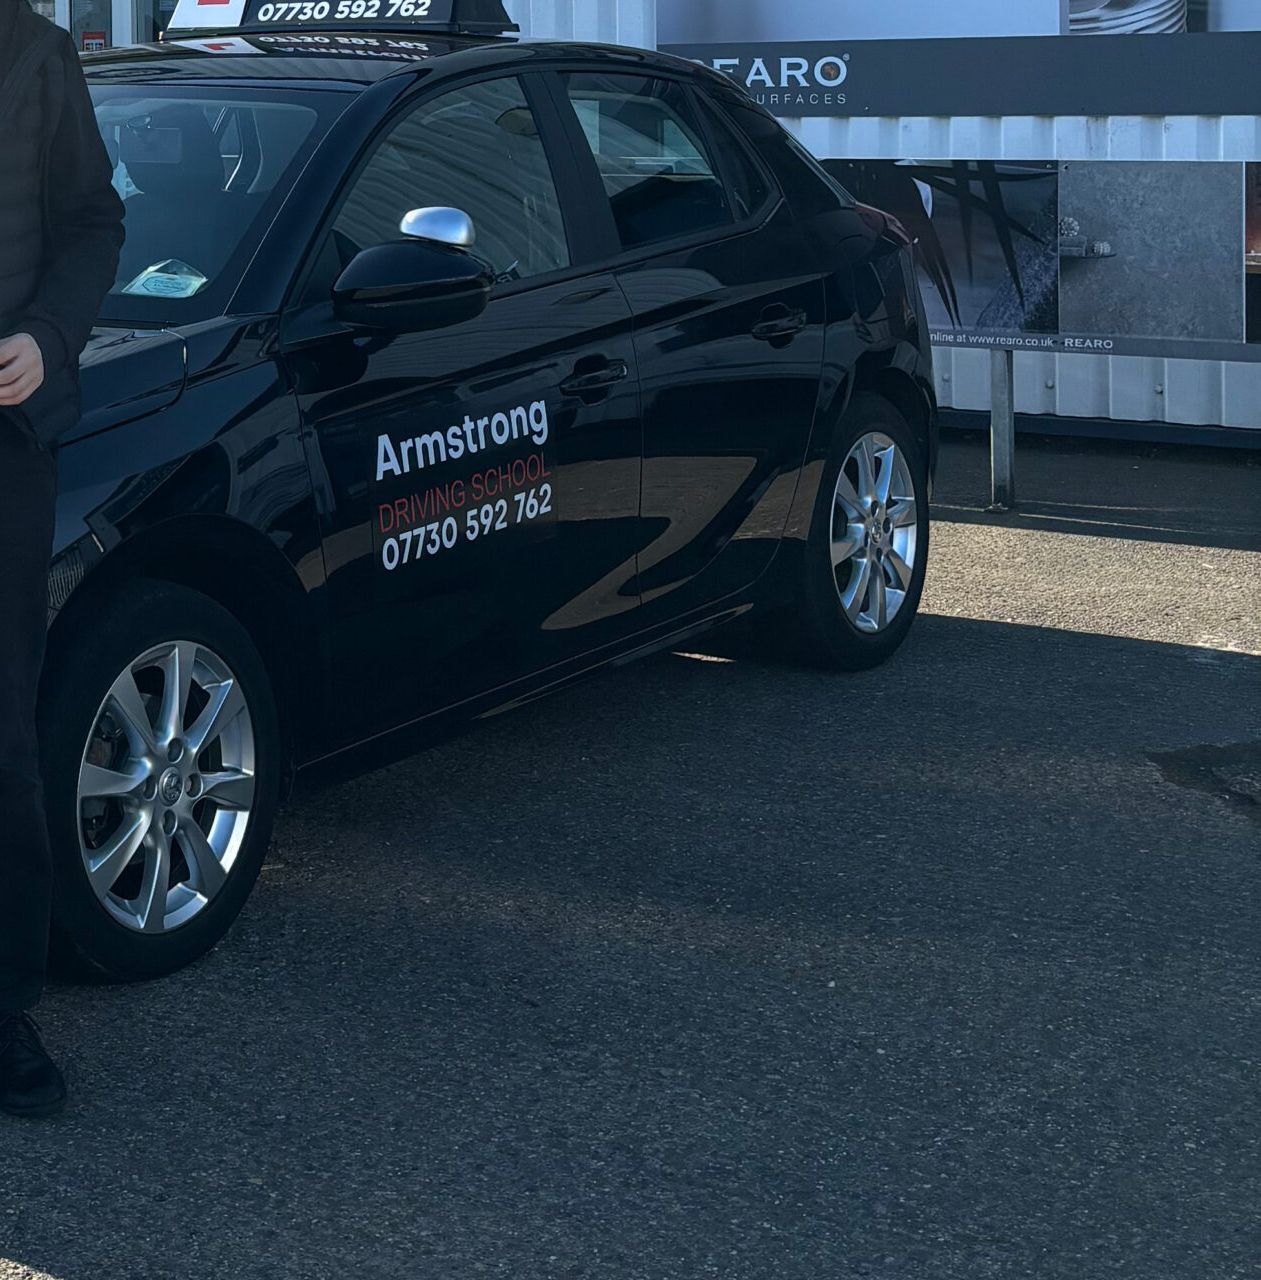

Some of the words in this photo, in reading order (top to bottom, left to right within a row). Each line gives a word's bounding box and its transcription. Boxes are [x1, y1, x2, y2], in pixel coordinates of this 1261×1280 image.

[257, 1, 330, 21] 07730
[335, 0, 379, 19] 592
[690, 55, 848, 87] EARO
[752, 93, 846, 105] URFACES
[930, 331, 954, 343] nline
[956, 333, 966, 343] at
[969, 334, 1054, 348] www.rearo.co.uk
[1064, 337, 1114, 349] REARO
[376, 400, 549, 481] Armstrong
[378, 479, 466, 533] DRIVING
[471, 451, 552, 502] SCHOOL
[382, 516, 458, 570] 07730
[466, 499, 508, 541] 592
[514, 483, 553, 523] 762
